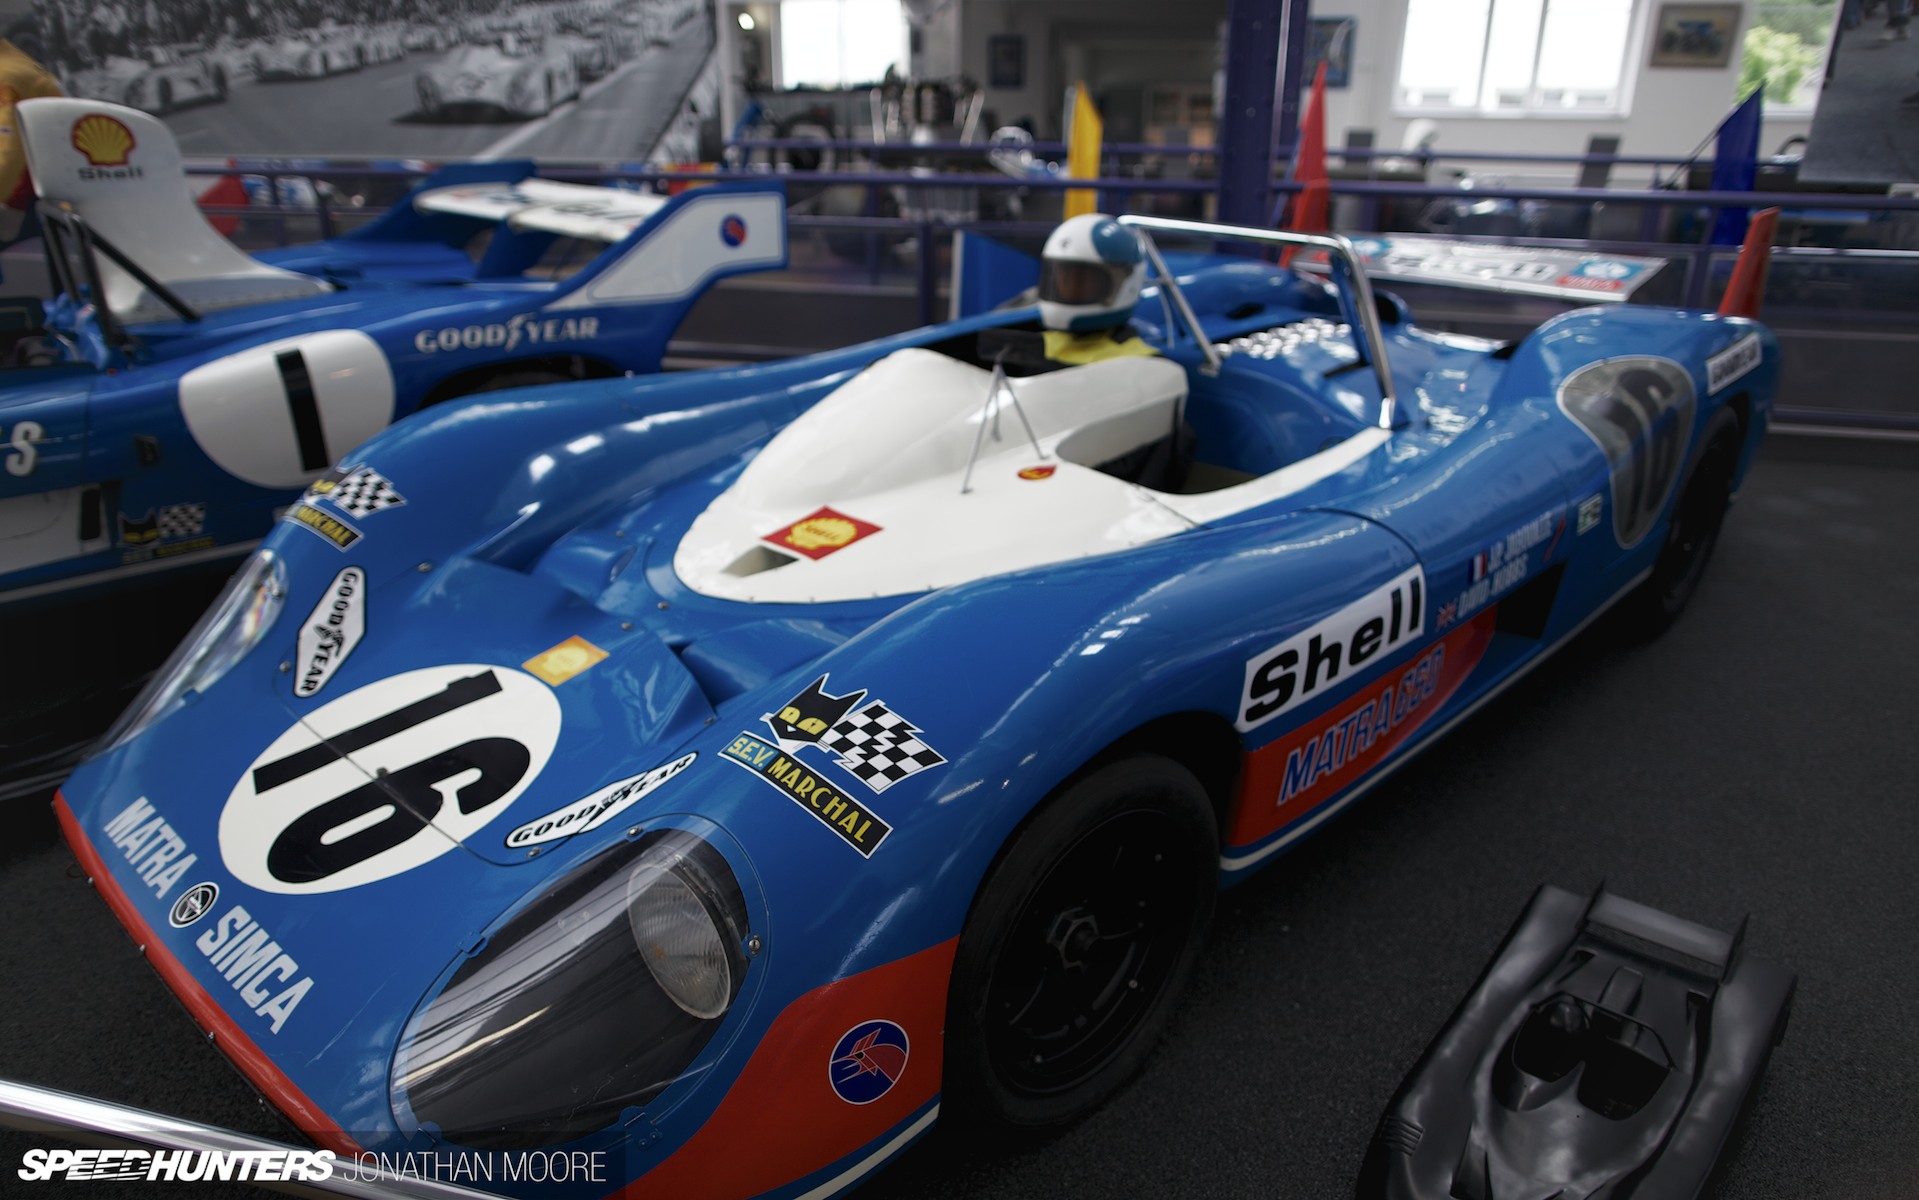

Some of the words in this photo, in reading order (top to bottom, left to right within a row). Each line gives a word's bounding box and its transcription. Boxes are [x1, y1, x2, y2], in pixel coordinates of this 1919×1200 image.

[79, 168, 143, 180] Shell
[275, 349, 329, 471] 1
[1245, 576, 1421, 722] Shell
[253, 669, 531, 884] 16
[513, 756, 692, 843] GOODYEAR
[727, 737, 774, 768] S.E.V.
[767, 757, 873, 843] MARCHAL
[1277, 685, 1394, 806] MATRA
[103, 796, 198, 899] MATRA
[196, 905, 315, 1035] SIMCA
